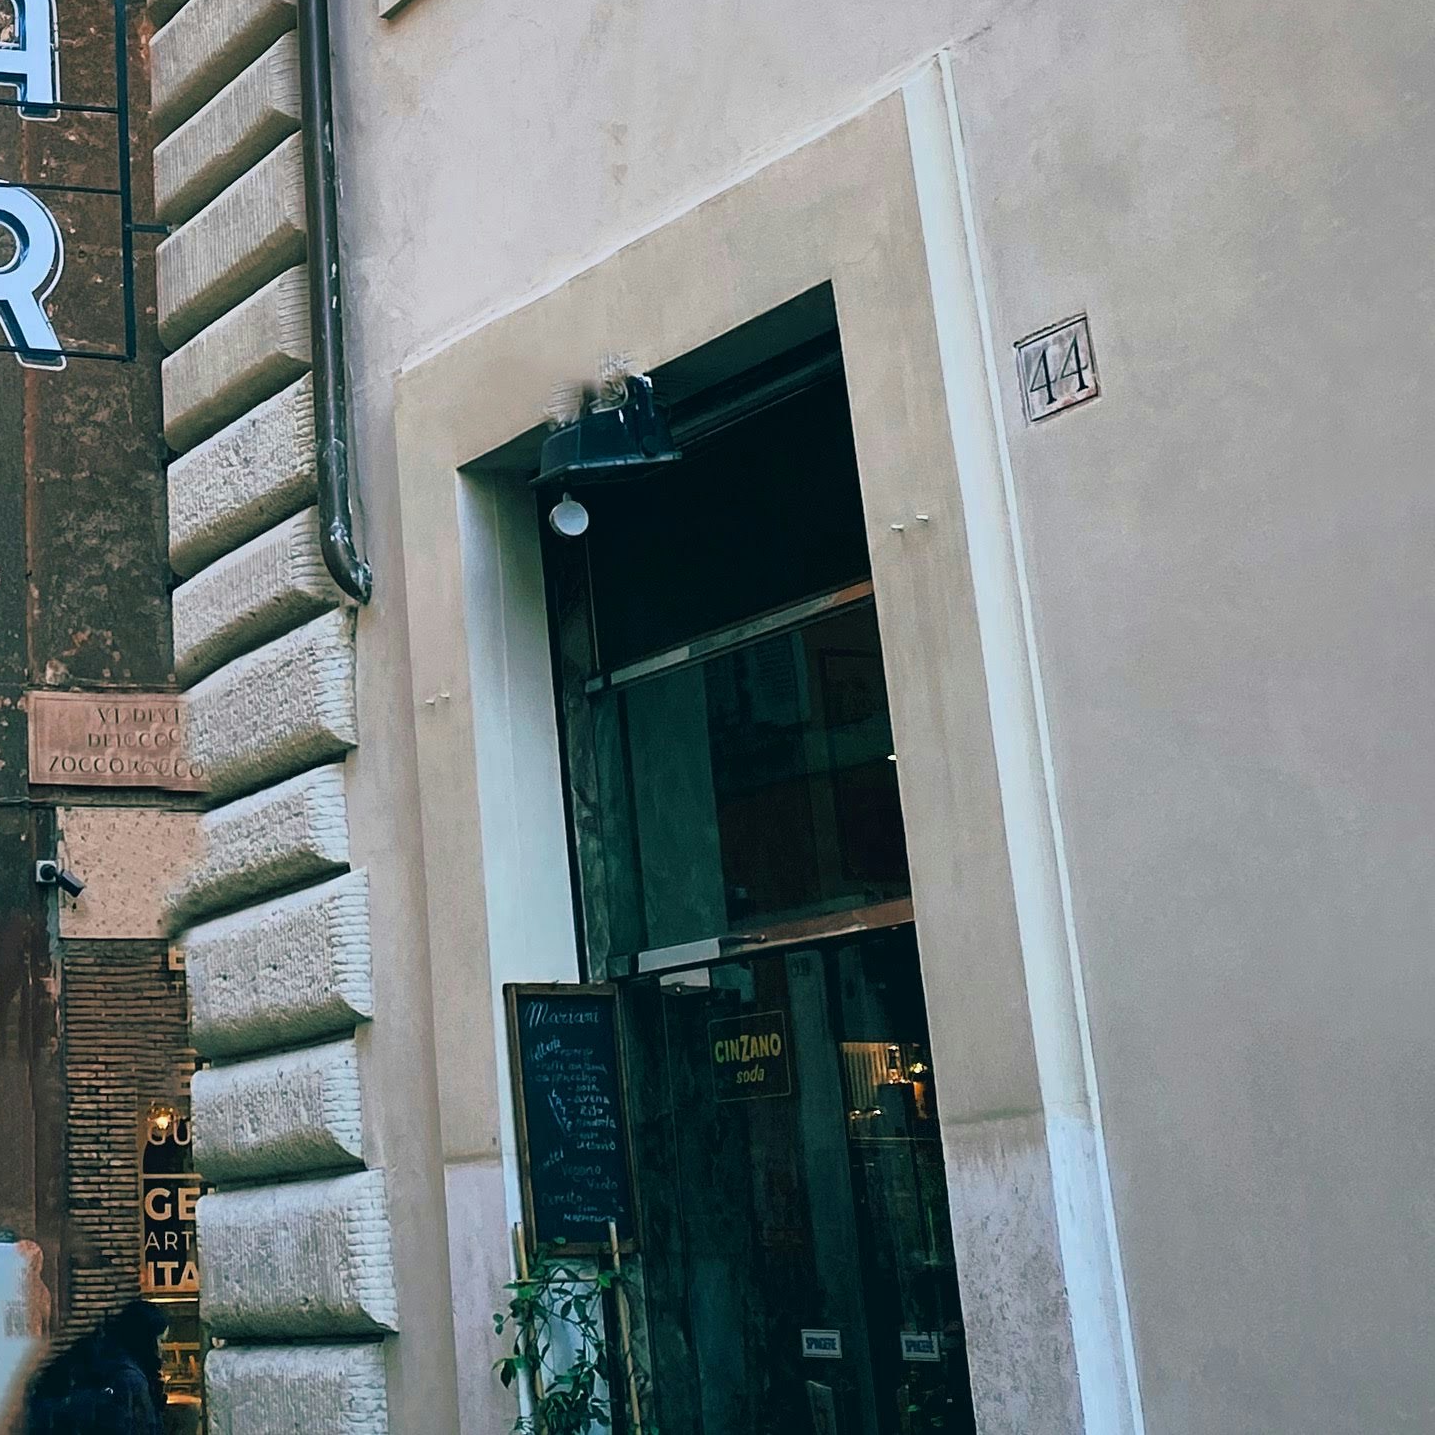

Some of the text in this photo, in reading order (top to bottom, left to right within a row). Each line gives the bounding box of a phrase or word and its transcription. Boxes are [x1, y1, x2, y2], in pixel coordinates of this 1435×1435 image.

[1029, 333, 1089, 406] 44
[714, 1032, 782, 1063] CINZANO
[736, 1064, 765, 1084] soda
[144, 1186, 216, 1221] GE
